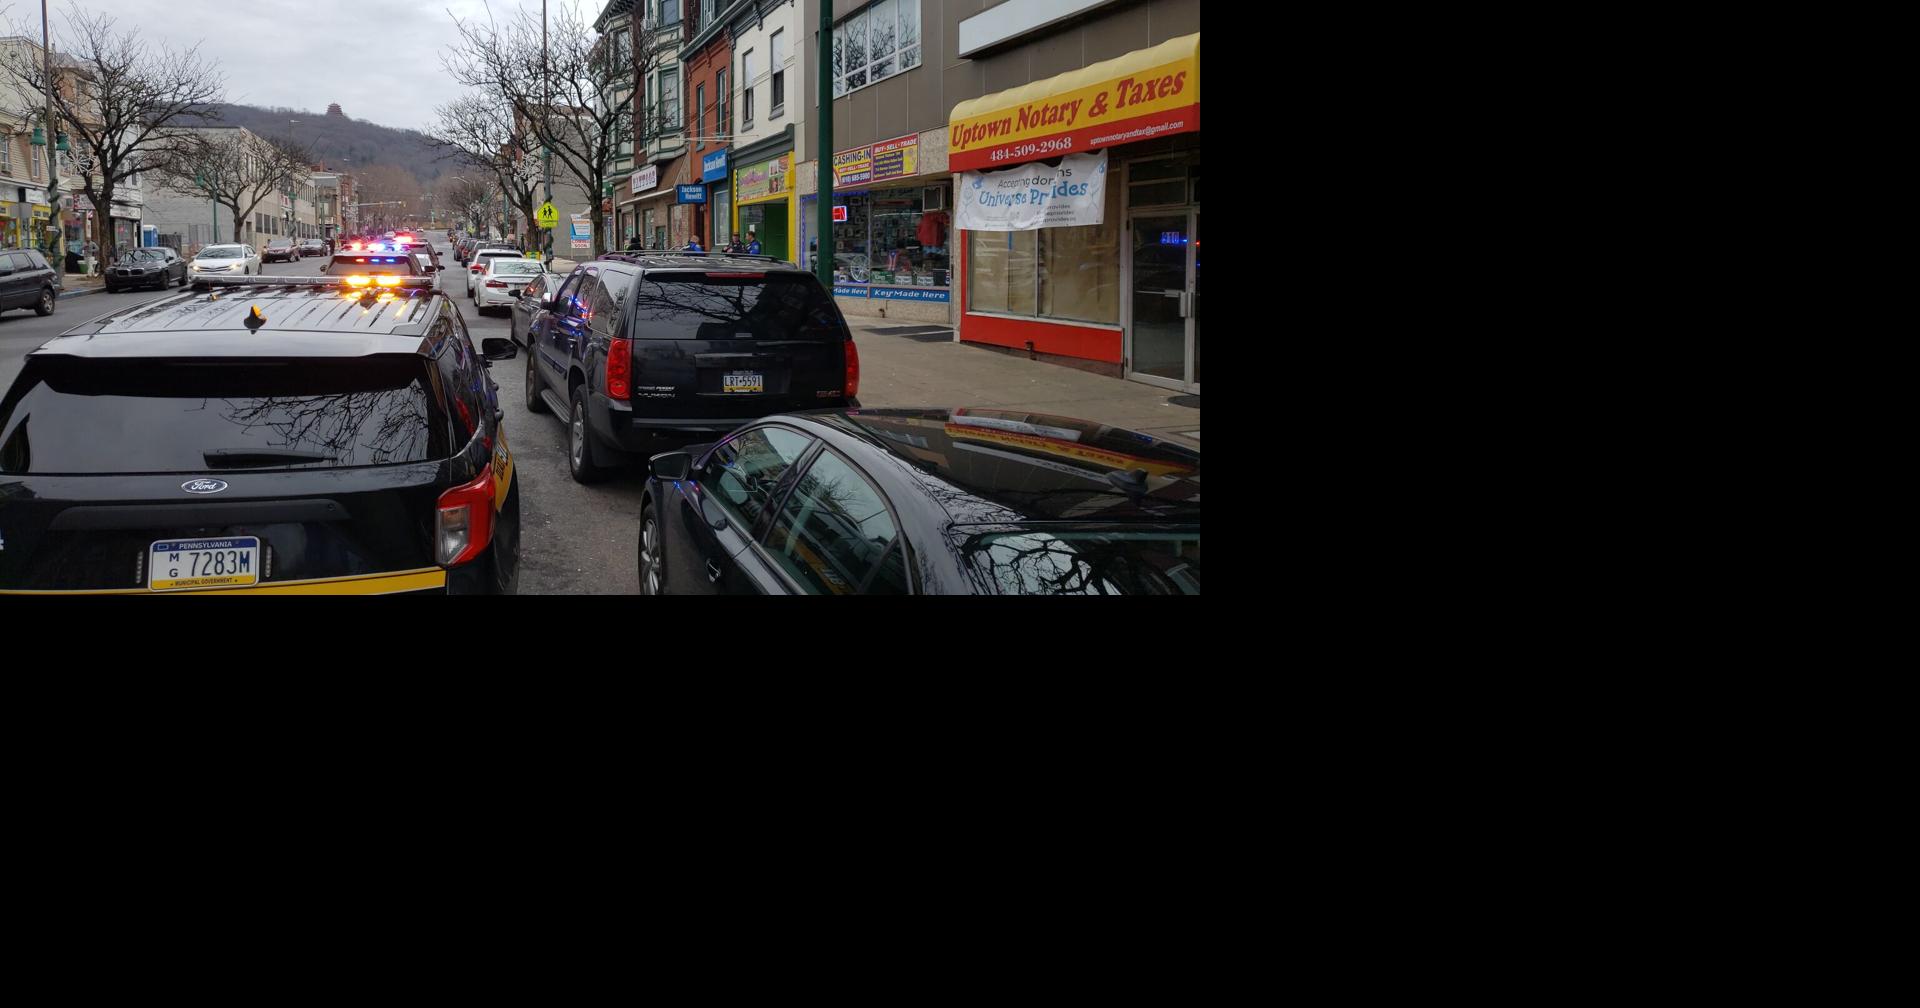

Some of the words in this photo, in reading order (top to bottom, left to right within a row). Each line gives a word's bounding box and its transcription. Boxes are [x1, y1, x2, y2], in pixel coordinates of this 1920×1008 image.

[952, 117, 1011, 149] Uptown
[1016, 98, 1082, 132] Notary
[1088, 91, 1108, 117] &
[1116, 70, 1186, 109] Taxes
[990, 137, 1073, 161] 484-509-2968
[922, 291, 946, 299] Here
[191, 480, 217, 490] Ford
[179, 541, 232, 550] PENNSYLVANIA
[189, 551, 250, 577] 7283M
